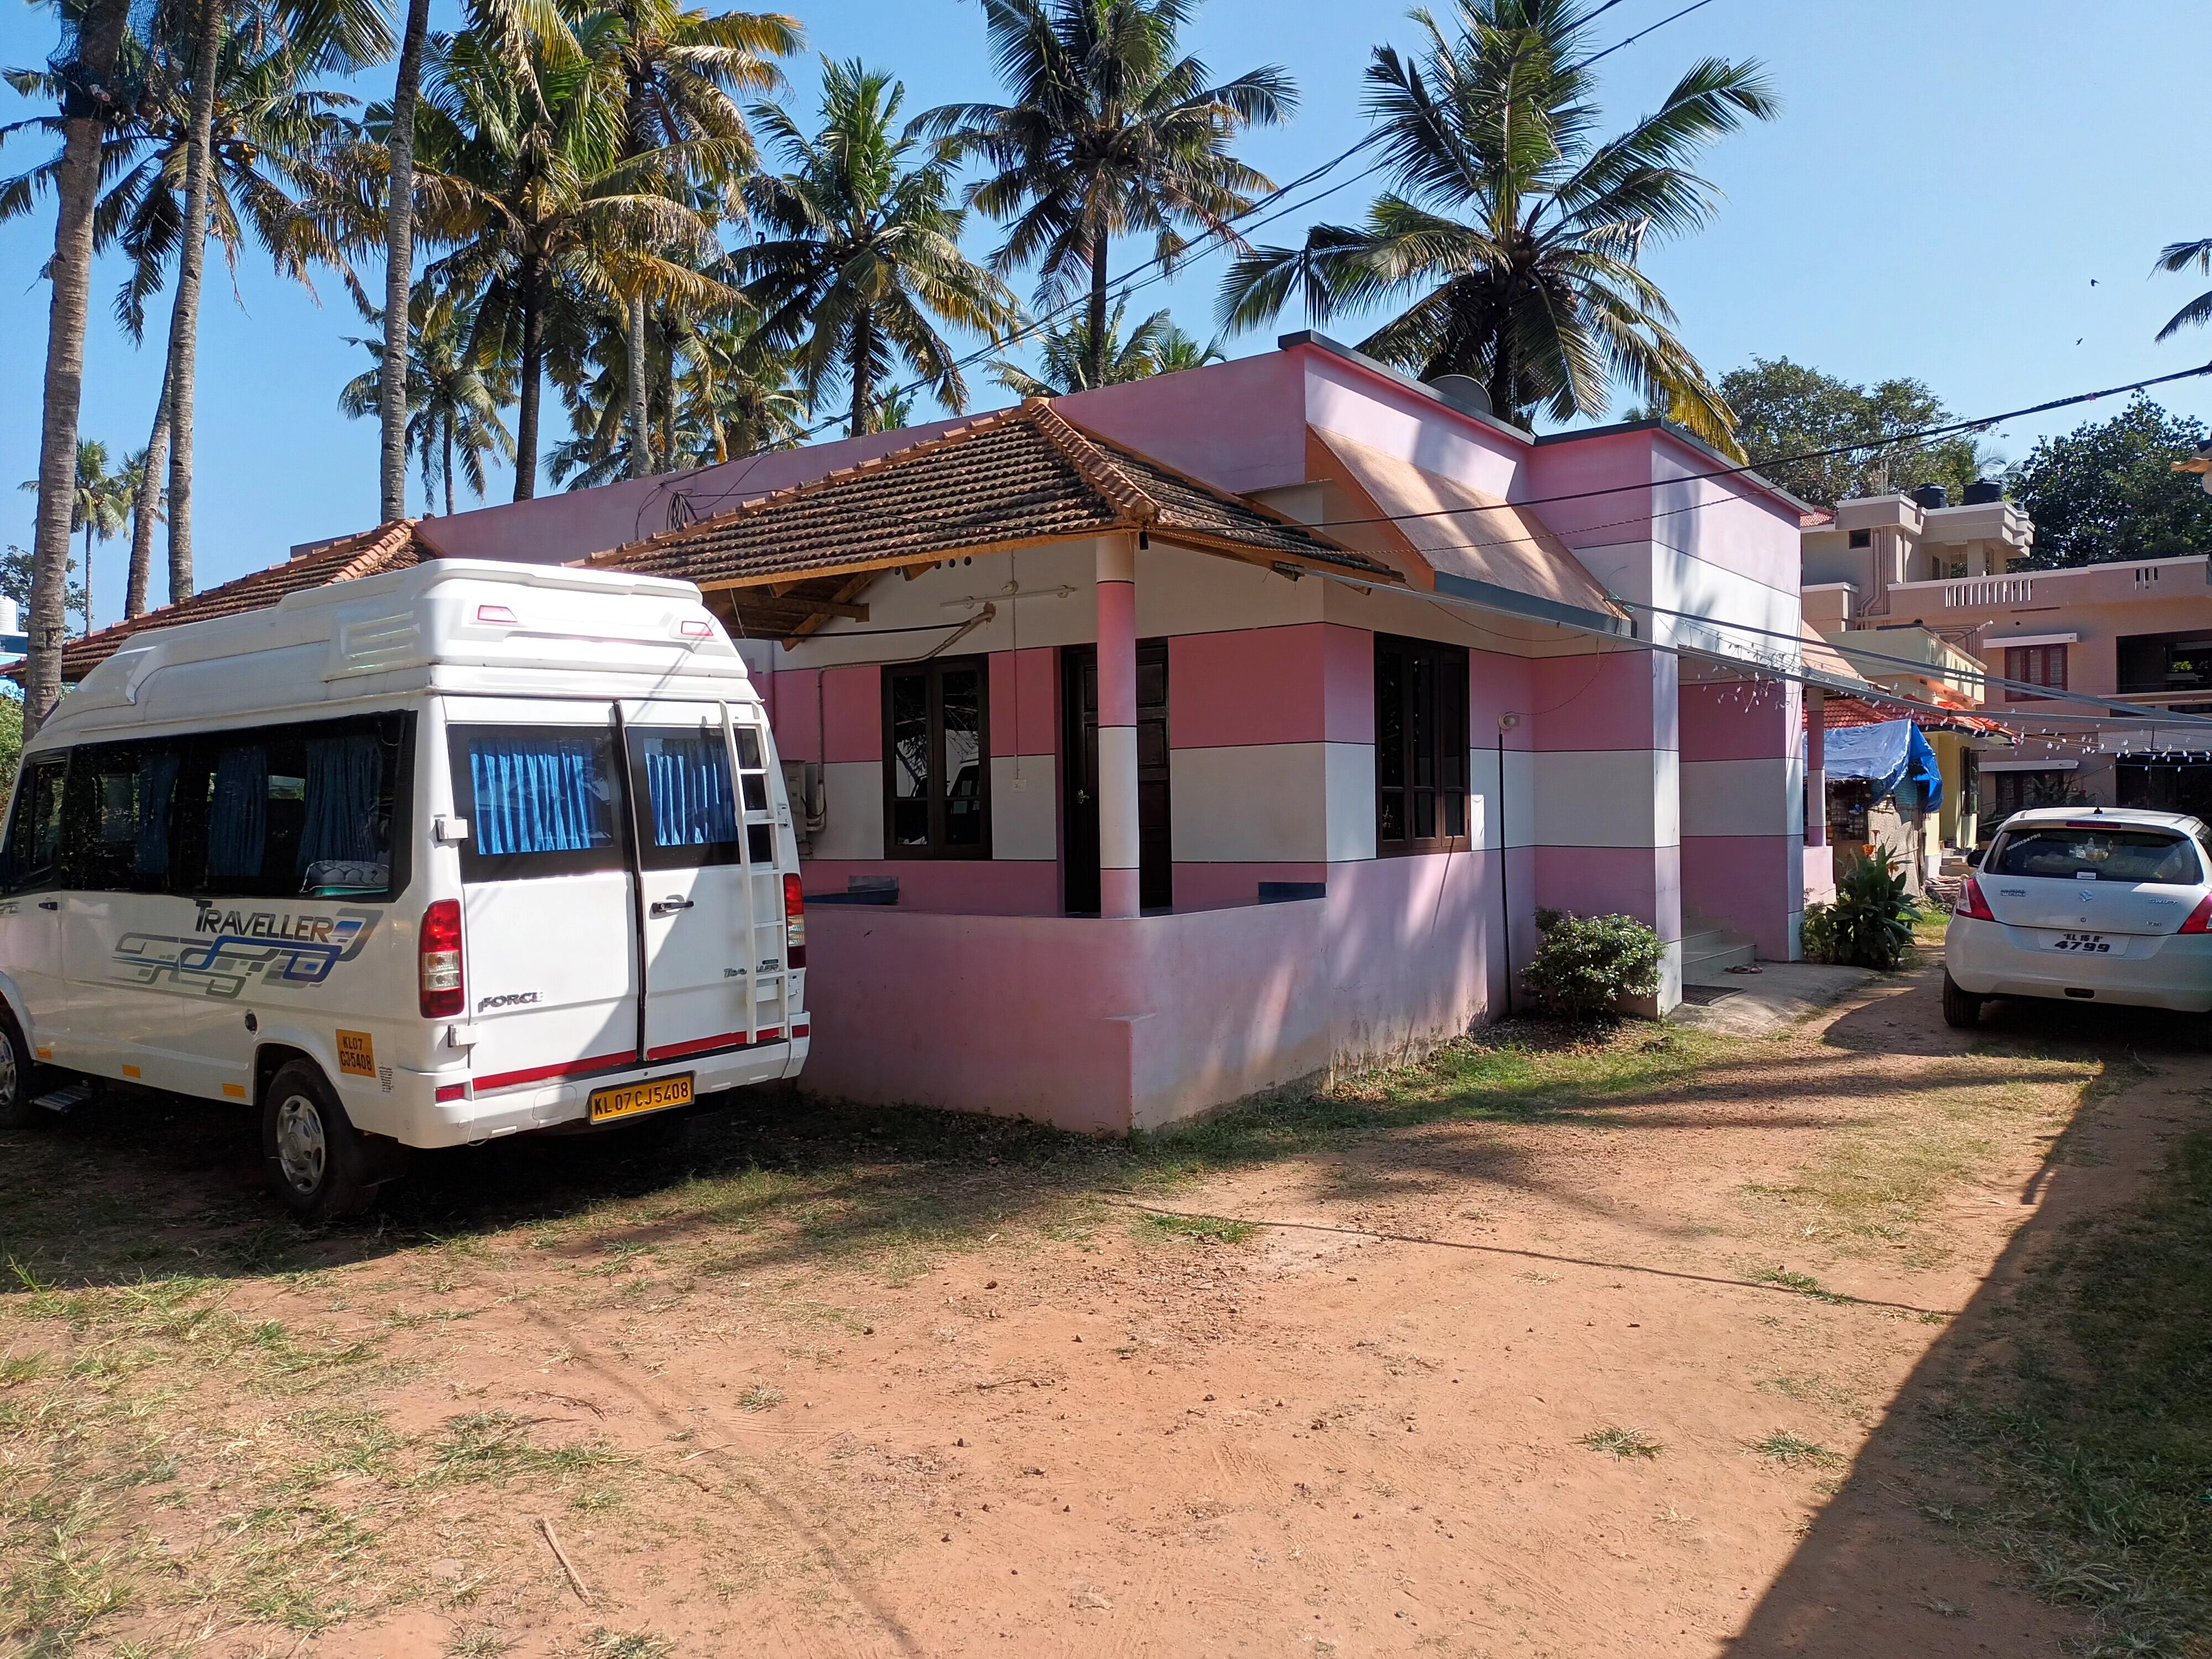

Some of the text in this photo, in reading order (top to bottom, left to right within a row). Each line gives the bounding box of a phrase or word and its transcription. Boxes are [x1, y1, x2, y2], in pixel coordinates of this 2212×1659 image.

[195, 900, 334, 943] TRAVELLER
[2054, 940, 2111, 953] 4799
[478, 992, 544, 1014] FORCE
